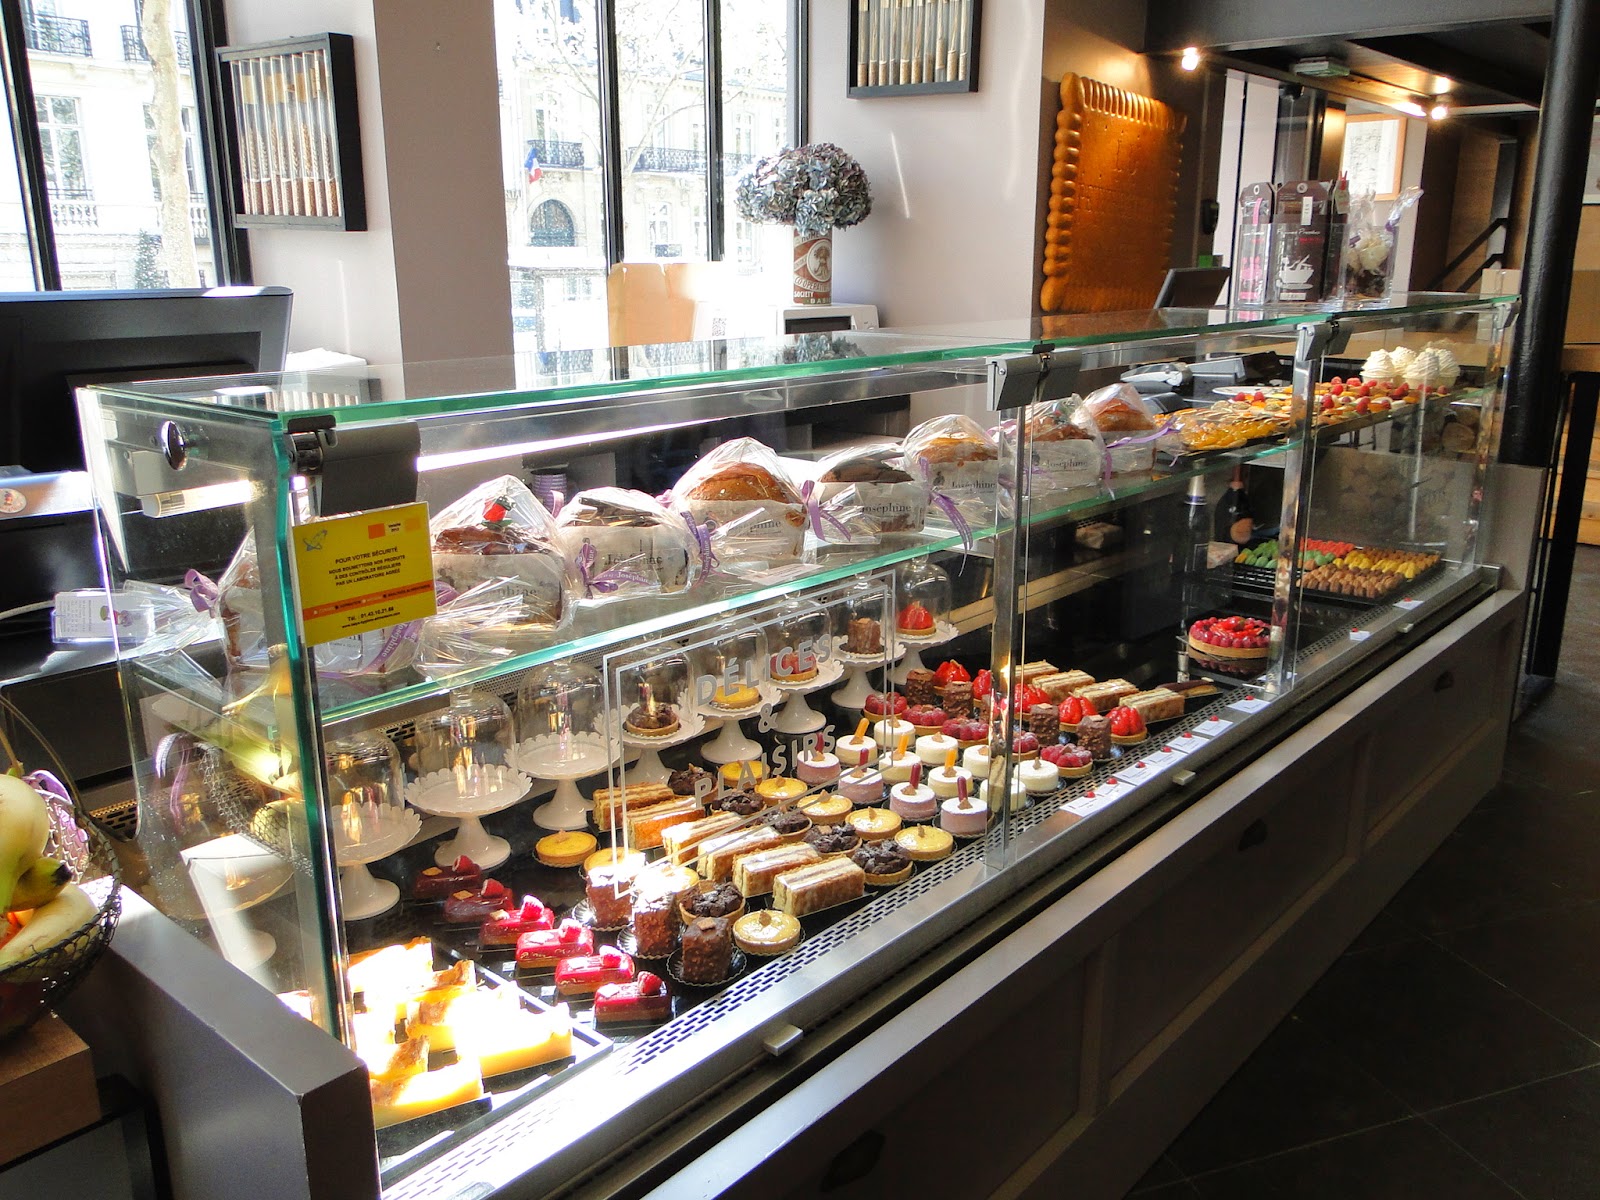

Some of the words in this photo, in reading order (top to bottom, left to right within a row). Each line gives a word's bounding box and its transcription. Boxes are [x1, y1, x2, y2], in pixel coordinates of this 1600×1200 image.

[335, 555, 352, 565] POUR
[352, 552, 370, 561] VOTRE
[372, 546, 398, 557] SÉCURITÉ
[696, 633, 832, 706] DÉLICES
[758, 703, 778, 733] &
[695, 725, 836, 809] PLAISIRS
